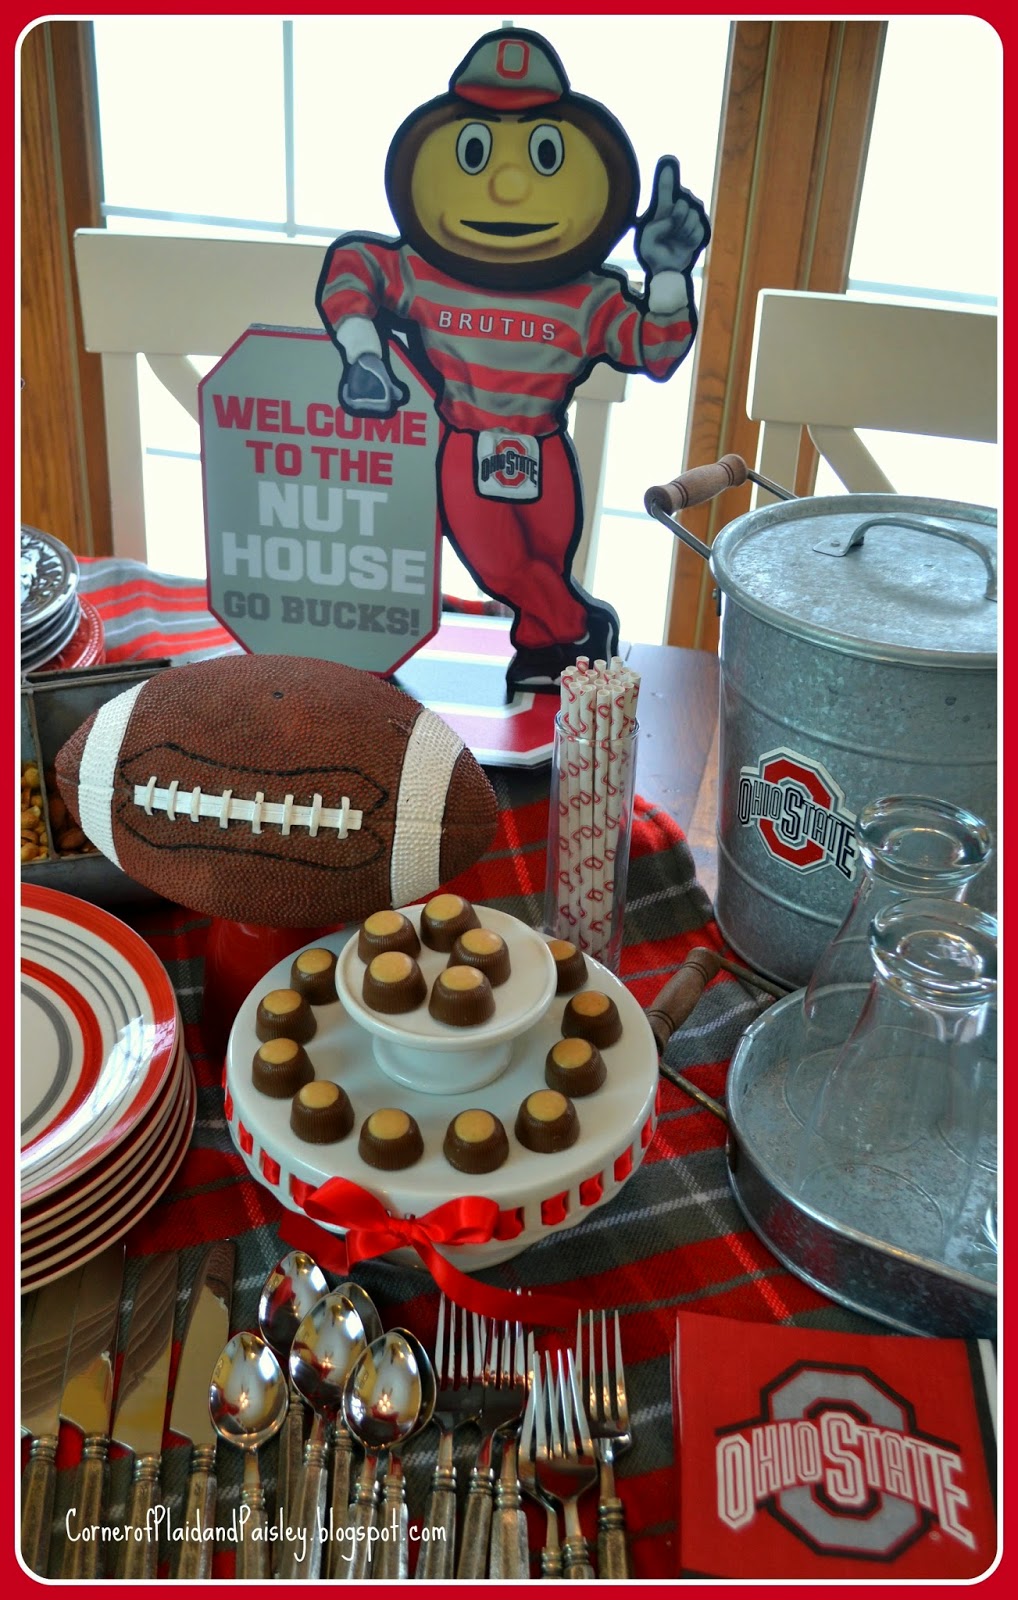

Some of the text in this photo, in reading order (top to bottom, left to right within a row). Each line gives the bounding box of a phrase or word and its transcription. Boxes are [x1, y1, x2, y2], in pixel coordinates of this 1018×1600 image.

[438, 310, 555, 341] BRUTUS
[212, 394, 428, 446] WELCOME
[246, 440, 393, 486] TO THE
[481, 450, 538, 486] OHIO STATE
[257, 480, 388, 537] NUT
[221, 531, 427, 595] HOUSE
[223, 590, 421, 637] GO BUCKS!
[738, 778, 856, 880] OHIO STATE
[715, 1411, 977, 1551] OHIO STATE
